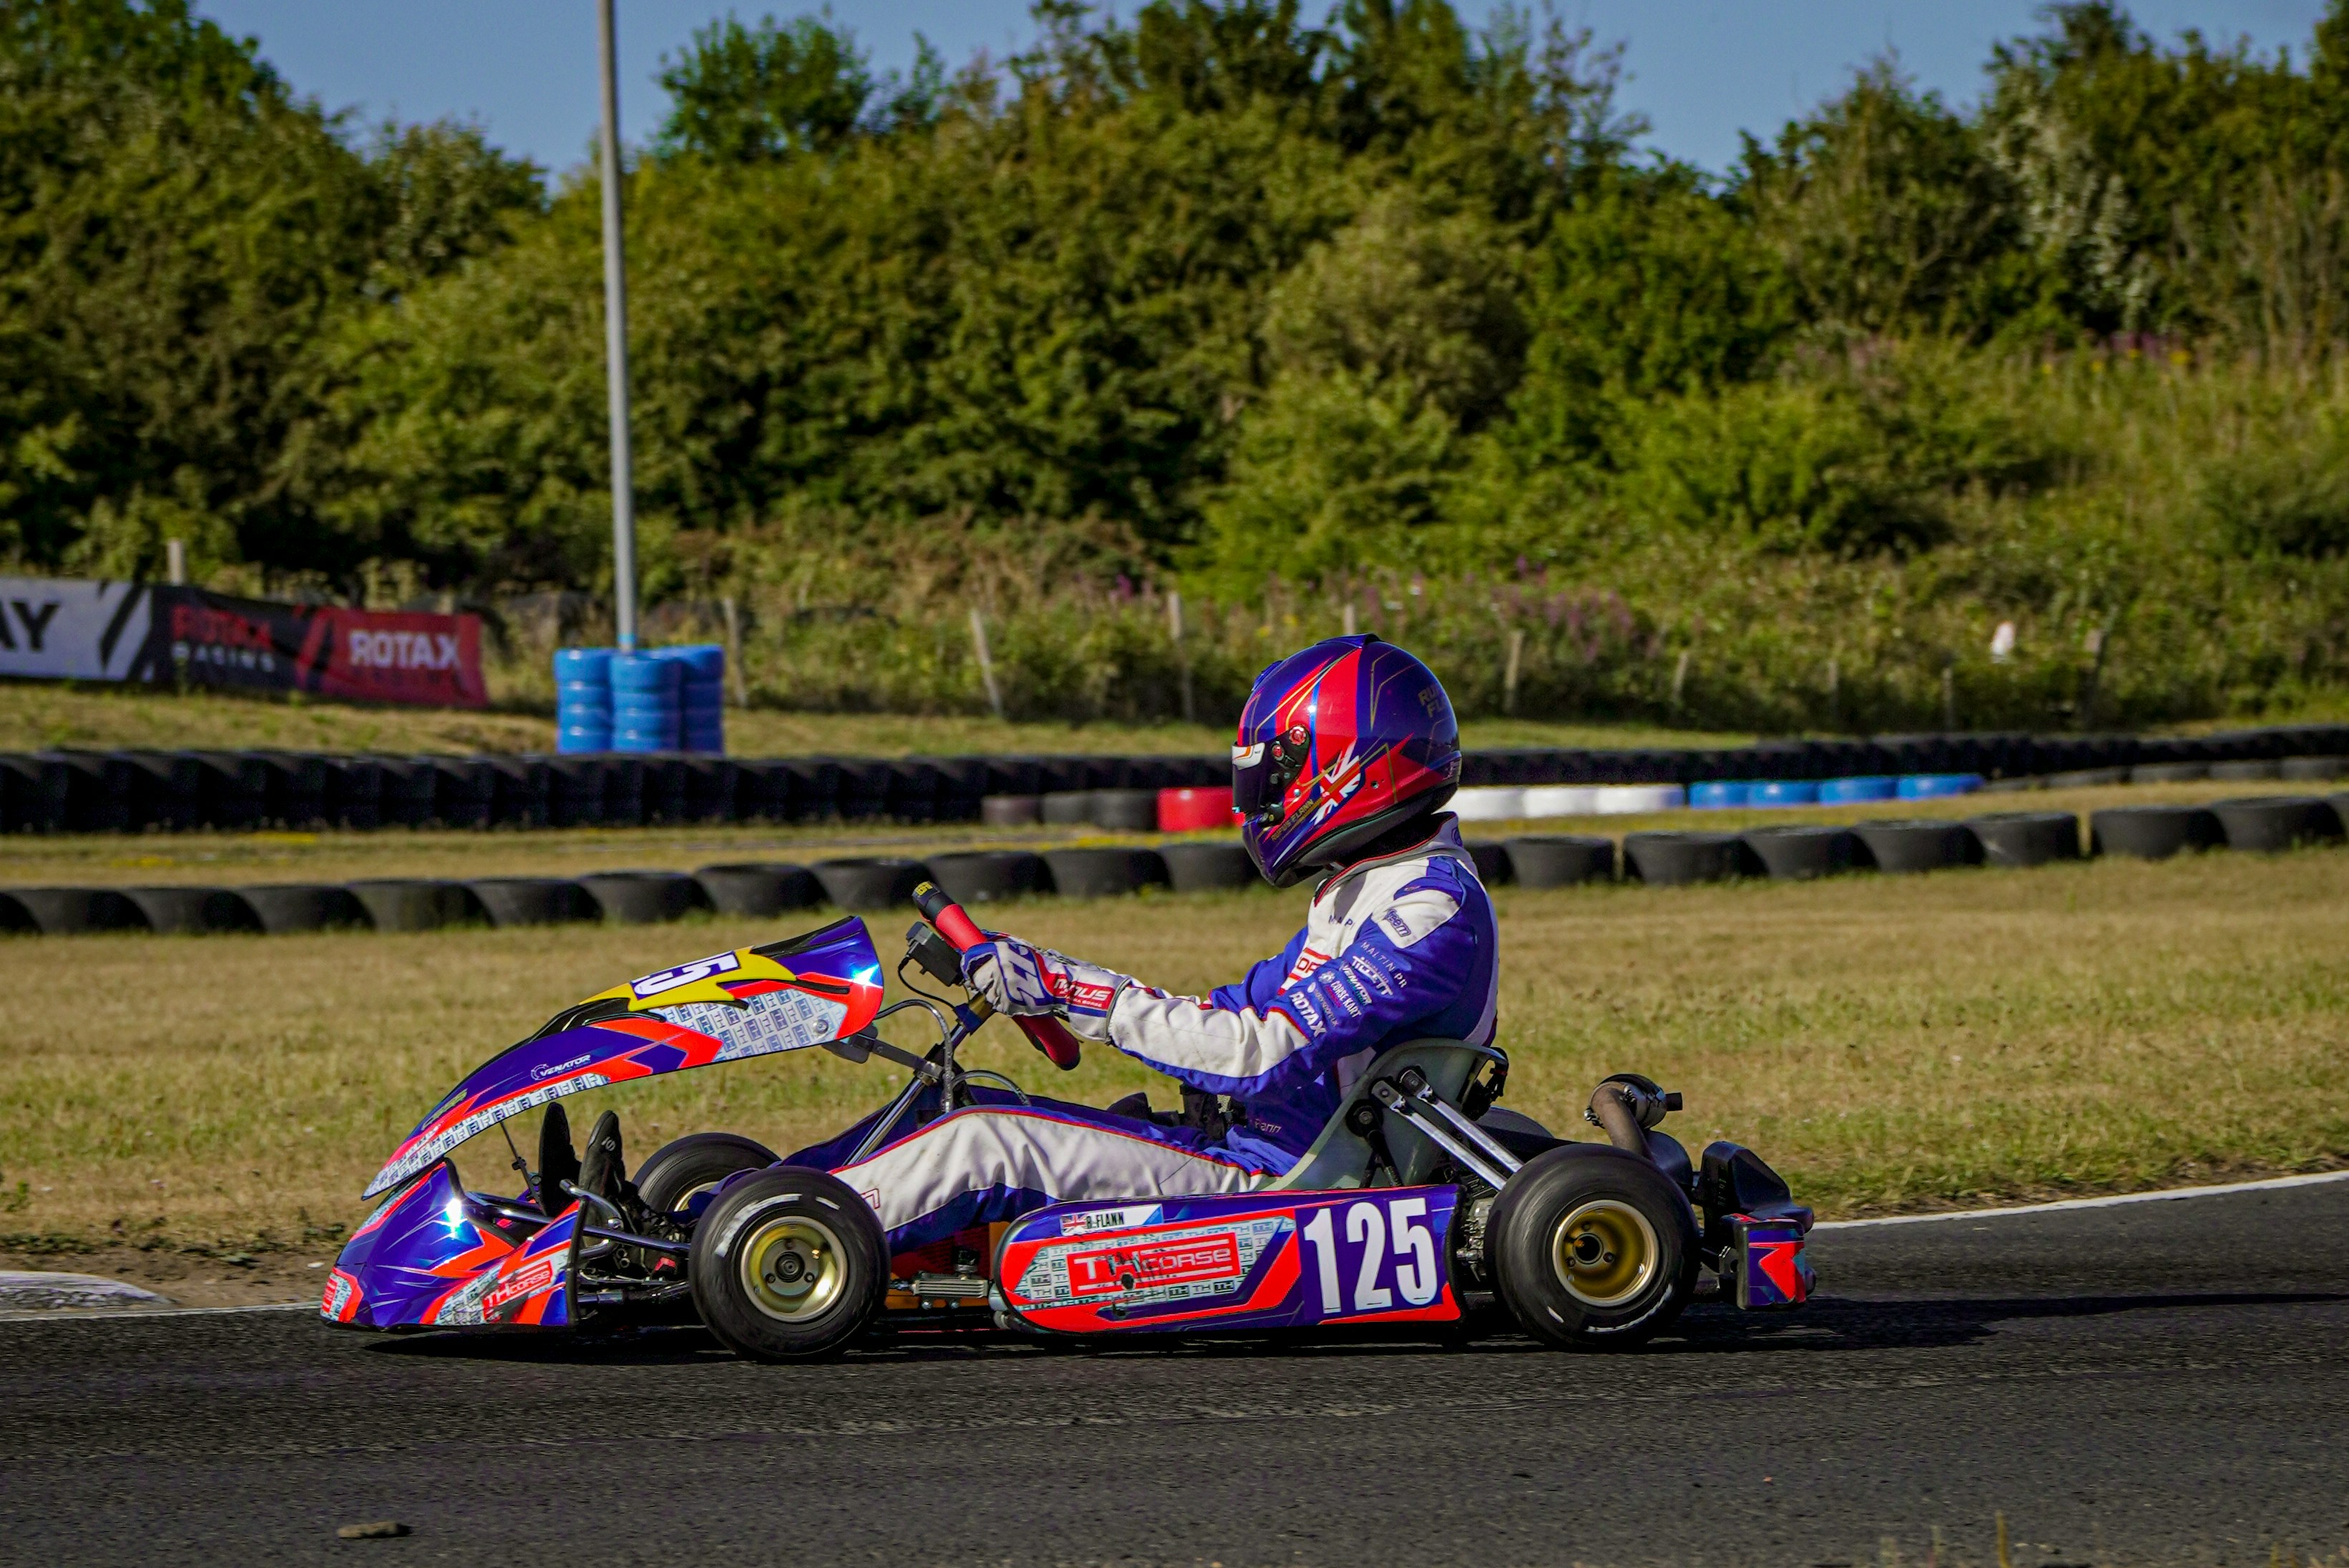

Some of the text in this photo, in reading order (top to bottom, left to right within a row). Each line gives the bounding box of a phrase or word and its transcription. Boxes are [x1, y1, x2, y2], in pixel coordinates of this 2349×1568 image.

[349, 629, 461, 670] ROTAX
[1352, 955, 1393, 996] TILLETT
[1360, 941, 1396, 972] MALTIN
[1394, 972, 1407, 988] PR
[1289, 991, 1327, 1037] ROTAX
[1330, 981, 1349, 1001] CORSE
[1343, 997, 1362, 1017] KART
[540, 1054, 591, 1077] VENATOR
[1303, 1197, 1438, 1314] 125
